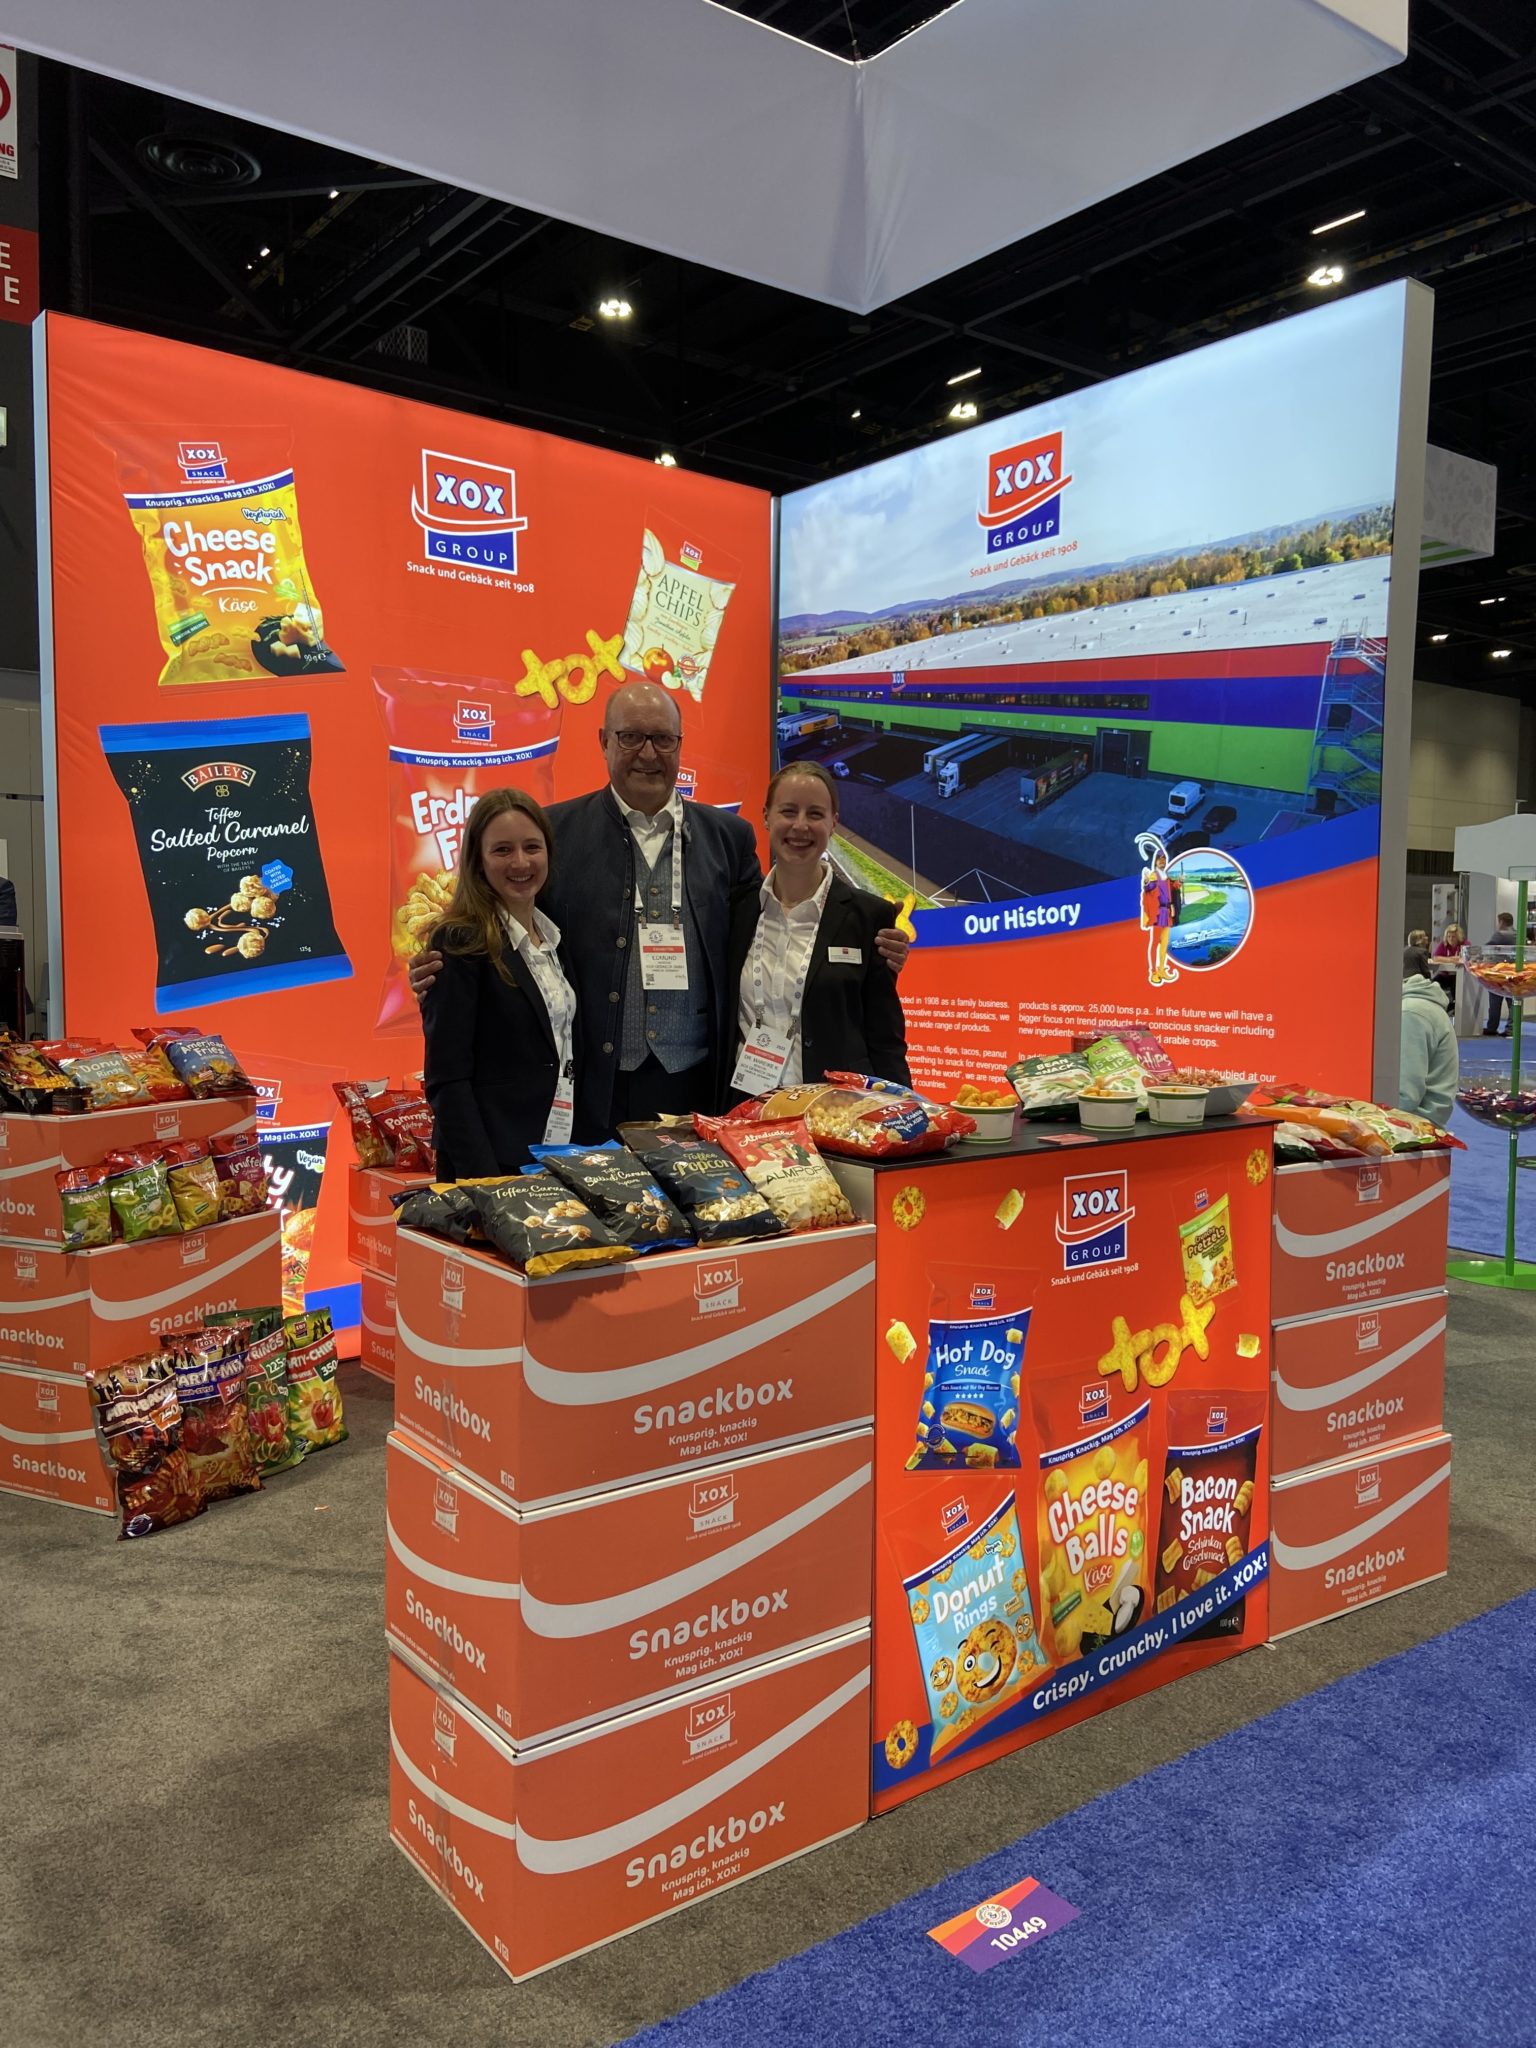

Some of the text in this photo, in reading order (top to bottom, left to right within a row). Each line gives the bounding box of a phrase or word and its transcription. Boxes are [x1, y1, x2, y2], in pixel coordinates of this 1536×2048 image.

[186, 449, 217, 460] XOX
[994, 451, 1054, 497] XOX
[145, 482, 276, 507] Knusprig. Knackig. Mag XOX!
[434, 472, 506, 515] XOX
[163, 521, 277, 558] Cheese
[992, 520, 1055, 547] GROUP
[435, 540, 508, 564] GROUP
[684, 547, 699, 559] XOX
[969, 540, 1078, 578] Snack und Gebäck seit 1908
[185, 553, 273, 586] Snack
[407, 561, 535, 594] Snack und Gebäck seit 1908
[658, 573, 703, 612] APFEL
[218, 597, 258, 613] Käse
[655, 590, 702, 627] CHIPS
[462, 708, 487, 721] XOX
[415, 751, 533, 767] Knusprig. Knackig. Mag XOX!
[188, 766, 249, 785] BAILEYS
[205, 807, 241, 824] Toffee
[151, 815, 310, 852] Salted Caramel
[207, 846, 259, 863] Popcorn
[964, 902, 1081, 936] Our History
[933, 1010, 954, 1018] snacks
[957, 997, 1009, 1009] family business.
[1019, 1001, 1264, 1021] products 25,000 tons In the future we will have
[962, 1023, 992, 1033] products.
[1019, 1014, 1275, 1038] bigger focus on trend conscious snacker including
[1019, 1027, 1033, 1035] new
[983, 1048, 1007, 1059] peanut
[1164, 1035, 1219, 1048] arable crops.
[945, 1057, 1007, 1072] snack everyone
[1034, 1062, 1076, 1076] SNACK
[1036, 1058, 1069, 1071] BEAN
[1260, 1074, 1276, 1083] our
[158, 1114, 176, 1124] XOX
[264, 1130, 320, 1143] Mag ich. XOX!
[297, 1151, 323, 1166] Vegan
[1071, 1188, 1120, 1218] XOX
[357, 1231, 393, 1258] Snackbox
[1070, 1243, 1122, 1261] GROUP
[1188, 1226, 1226, 1258] Pretzels
[445, 1268, 461, 1286] XOX
[704, 1269, 733, 1286] XOX
[1051, 1262, 1139, 1287] Snack und Gebäck seit 1908
[1325, 1253, 1405, 1281] Snackbox
[705, 1298, 733, 1308] SNACK
[976, 1287, 992, 1295] XOX
[1361, 1319, 1378, 1331] XOX
[0, 1327, 65, 1350] nackbox
[936, 1339, 1016, 1371] Hot Dog
[954, 1364, 991, 1377] Snack
[633, 1378, 794, 1435] Snackbox
[1085, 1388, 1105, 1402] XOX
[414, 1375, 492, 1442] Snackbox
[1326, 1396, 1405, 1432] Snackbox
[669, 1417, 758, 1446] Knusprig. knackig
[680, 1431, 748, 1457] Mag ich. XOX!
[12, 1453, 87, 1484] Snackbox
[1360, 1472, 1378, 1484] XOX
[438, 1488, 455, 1508] XOX
[699, 1485, 729, 1505] XOX
[1181, 1476, 1237, 1510] Bacon
[699, 1514, 728, 1528] SNACK
[946, 1503, 963, 1519] XOX
[1048, 1479, 1139, 1540] Cheese
[1180, 1506, 1236, 1541] Snack
[1065, 1513, 1128, 1575] Balls
[1187, 1536, 1222, 1555] Schinken
[1183, 1550, 1226, 1572] Geschmack
[1324, 1547, 1406, 1589] Snackbox
[933, 1554, 1005, 1624] Donut
[1083, 1563, 1114, 1592] Käse
[628, 1588, 789, 1660] Snackbox
[953, 1595, 998, 1634] Rings
[405, 1588, 487, 1673] Snackbox
[1031, 1551, 1268, 1712] Crispy. Crunchy. I love it. XOX!
[664, 1631, 753, 1668] Knusprig. knackig
[675, 1646, 743, 1678] Mag ich. XOX!
[436, 1708, 454, 1730] XOX
[696, 1704, 726, 1727] XOX
[696, 1733, 725, 1748] SNACK
[408, 1798, 486, 1902] Snackbox
[625, 1801, 786, 1888] Snackbox
[661, 1848, 750, 1893] Knusprig. knackig
[672, 1863, 741, 1901] Mag ich. XOX!
[990, 1916, 1047, 1951] 10449
